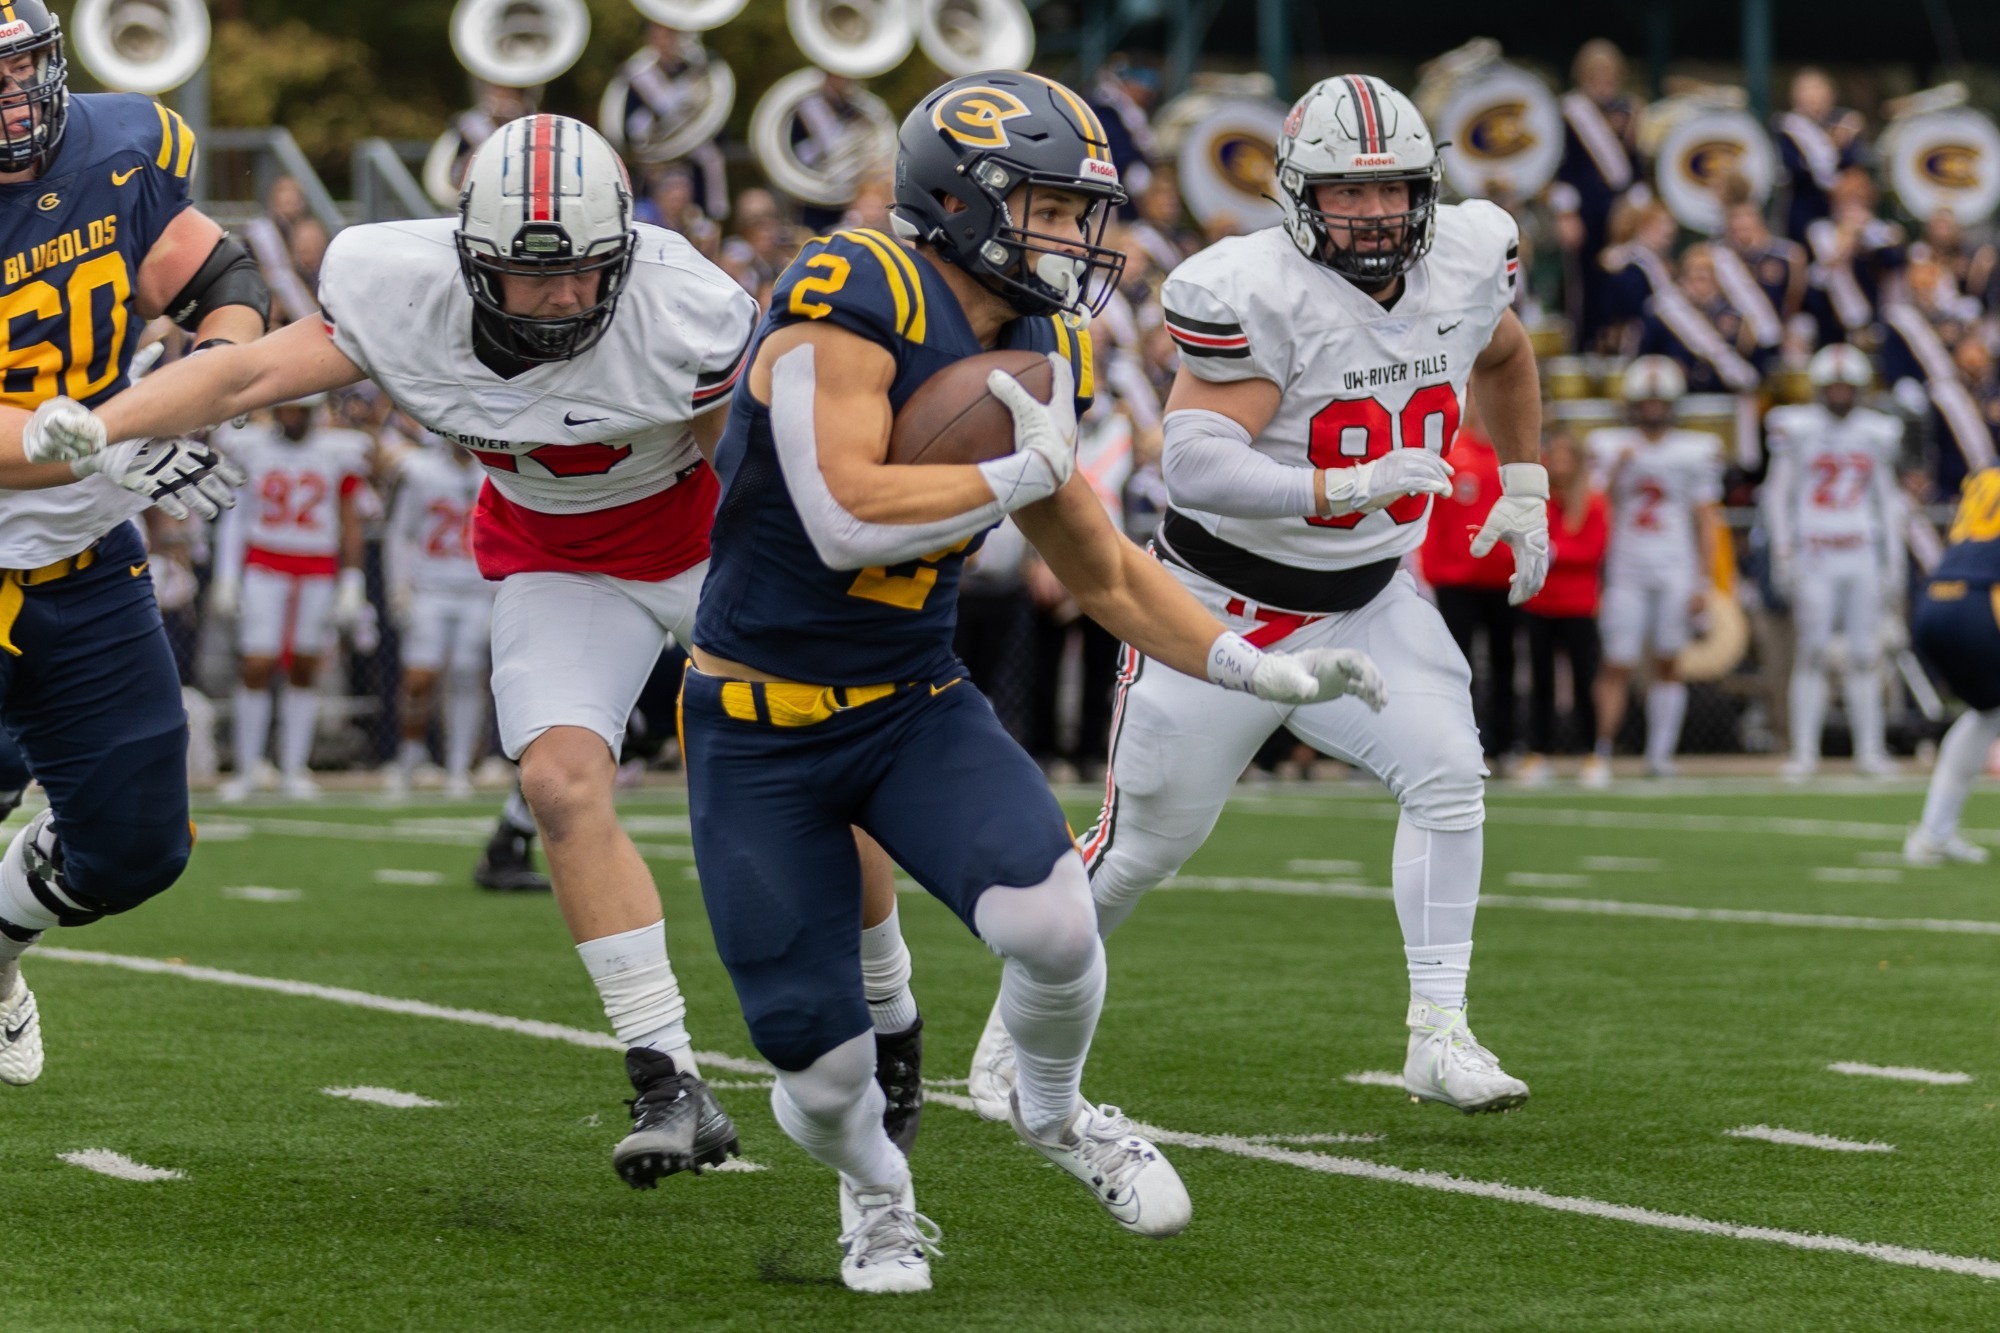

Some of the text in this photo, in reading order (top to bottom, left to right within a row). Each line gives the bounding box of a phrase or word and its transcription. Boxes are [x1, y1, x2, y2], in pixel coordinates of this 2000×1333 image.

[4, 214, 117, 286] BLUGOLDS
[789, 252, 852, 319] 2
[0, 250, 131, 411] 60
[1343, 354, 1448, 390] UW-RIVER FALLS
[259, 471, 327, 529] 92
[1633, 477, 1665, 531] 2
[1214, 648, 1242, 675] GMA
